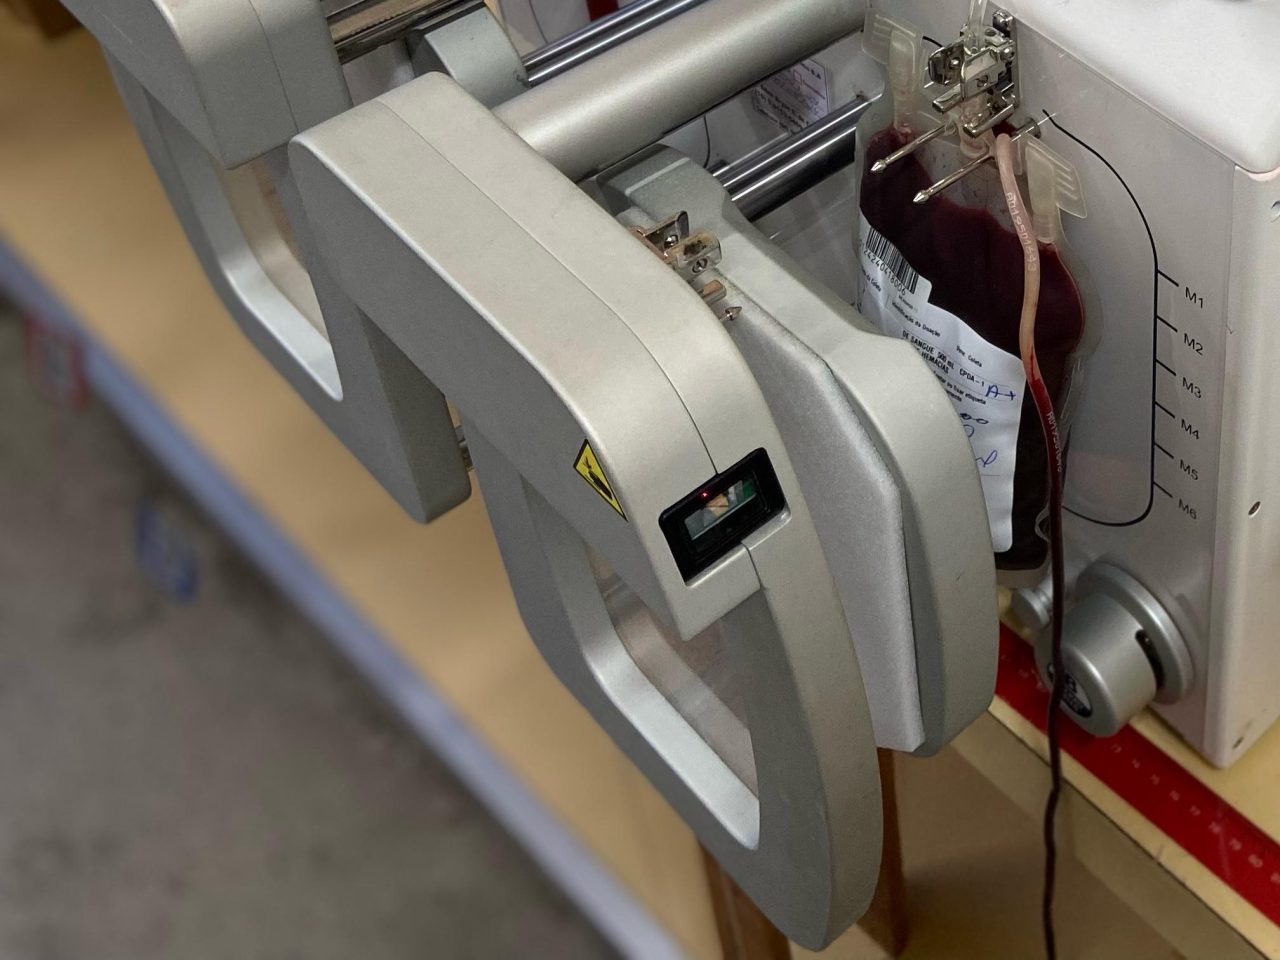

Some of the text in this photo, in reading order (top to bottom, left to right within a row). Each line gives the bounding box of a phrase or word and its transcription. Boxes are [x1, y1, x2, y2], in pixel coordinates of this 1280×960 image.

[1185, 287, 1204, 309] M1
[911, 336, 934, 355] SANGUE
[1184, 333, 1203, 355] M2
[1182, 377, 1202, 399] M3
[1181, 419, 1200, 440] M4
[1180, 459, 1199, 481] M5
[1178, 499, 1197, 520] M6
